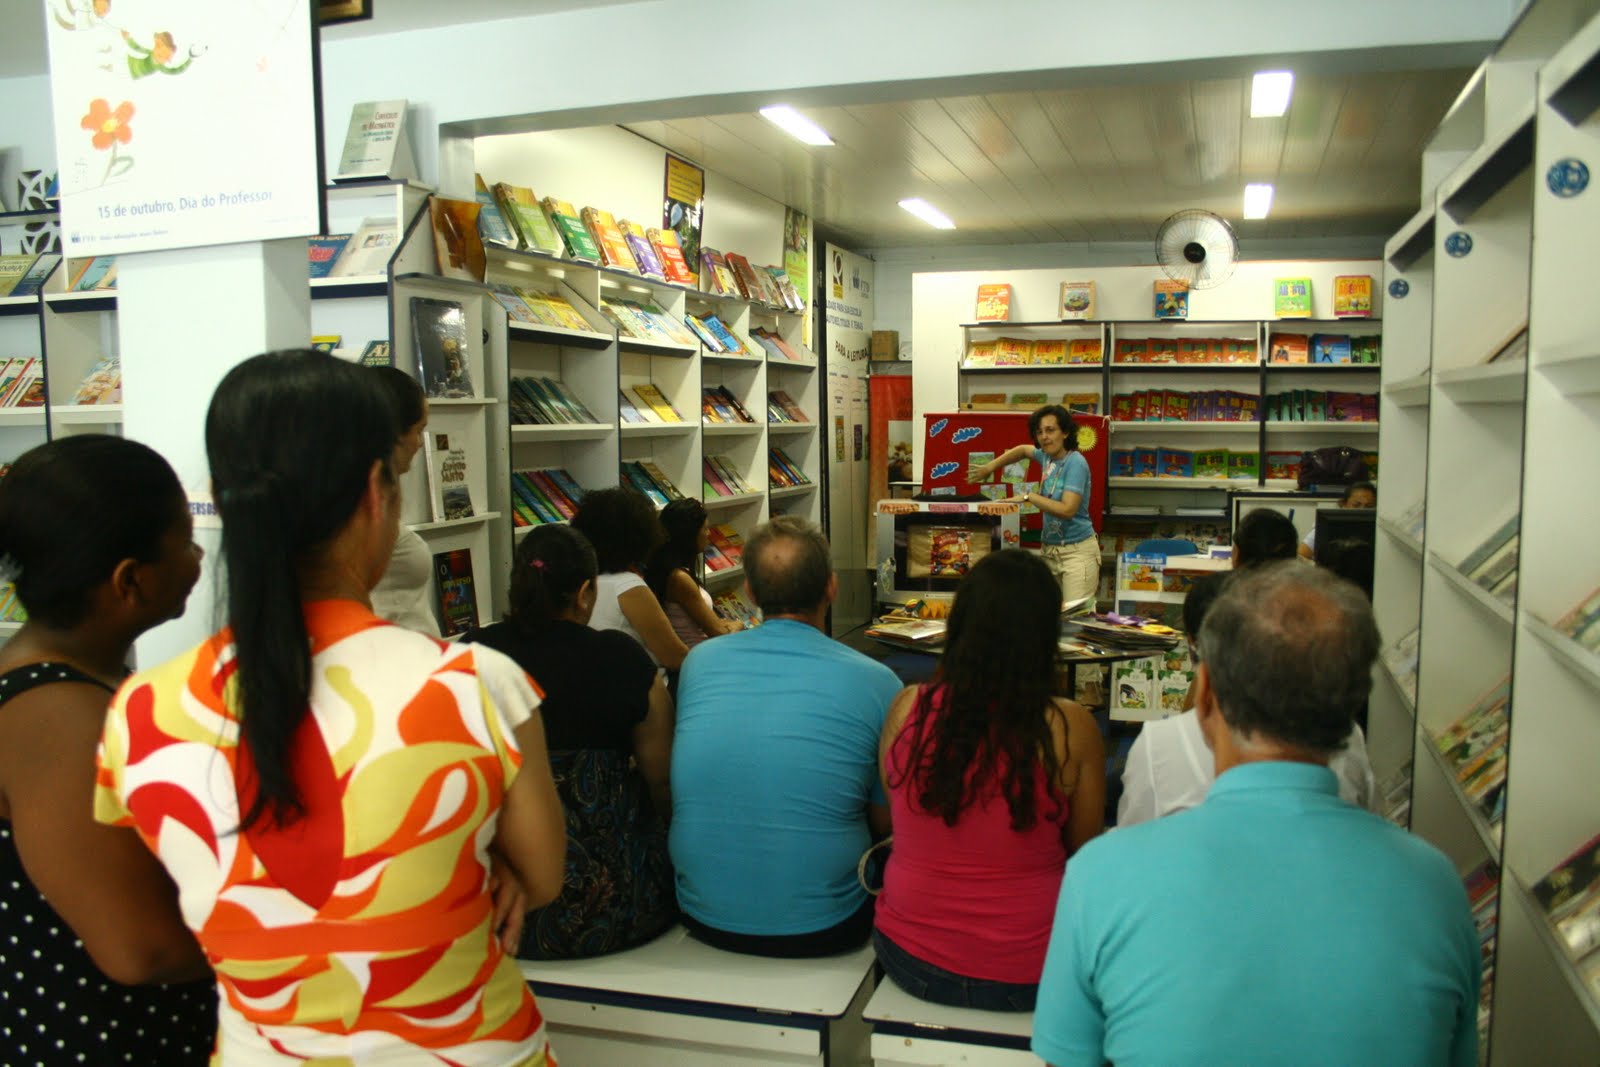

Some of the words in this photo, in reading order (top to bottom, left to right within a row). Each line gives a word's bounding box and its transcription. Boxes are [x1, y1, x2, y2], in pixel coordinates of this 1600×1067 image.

[98, 205, 111, 219] 15
[114, 204, 127, 217] de
[130, 199, 177, 215] outubro,
[179, 196, 197, 210] Dia
[201, 195, 215, 208] do
[219, 190, 273, 206] Professor
